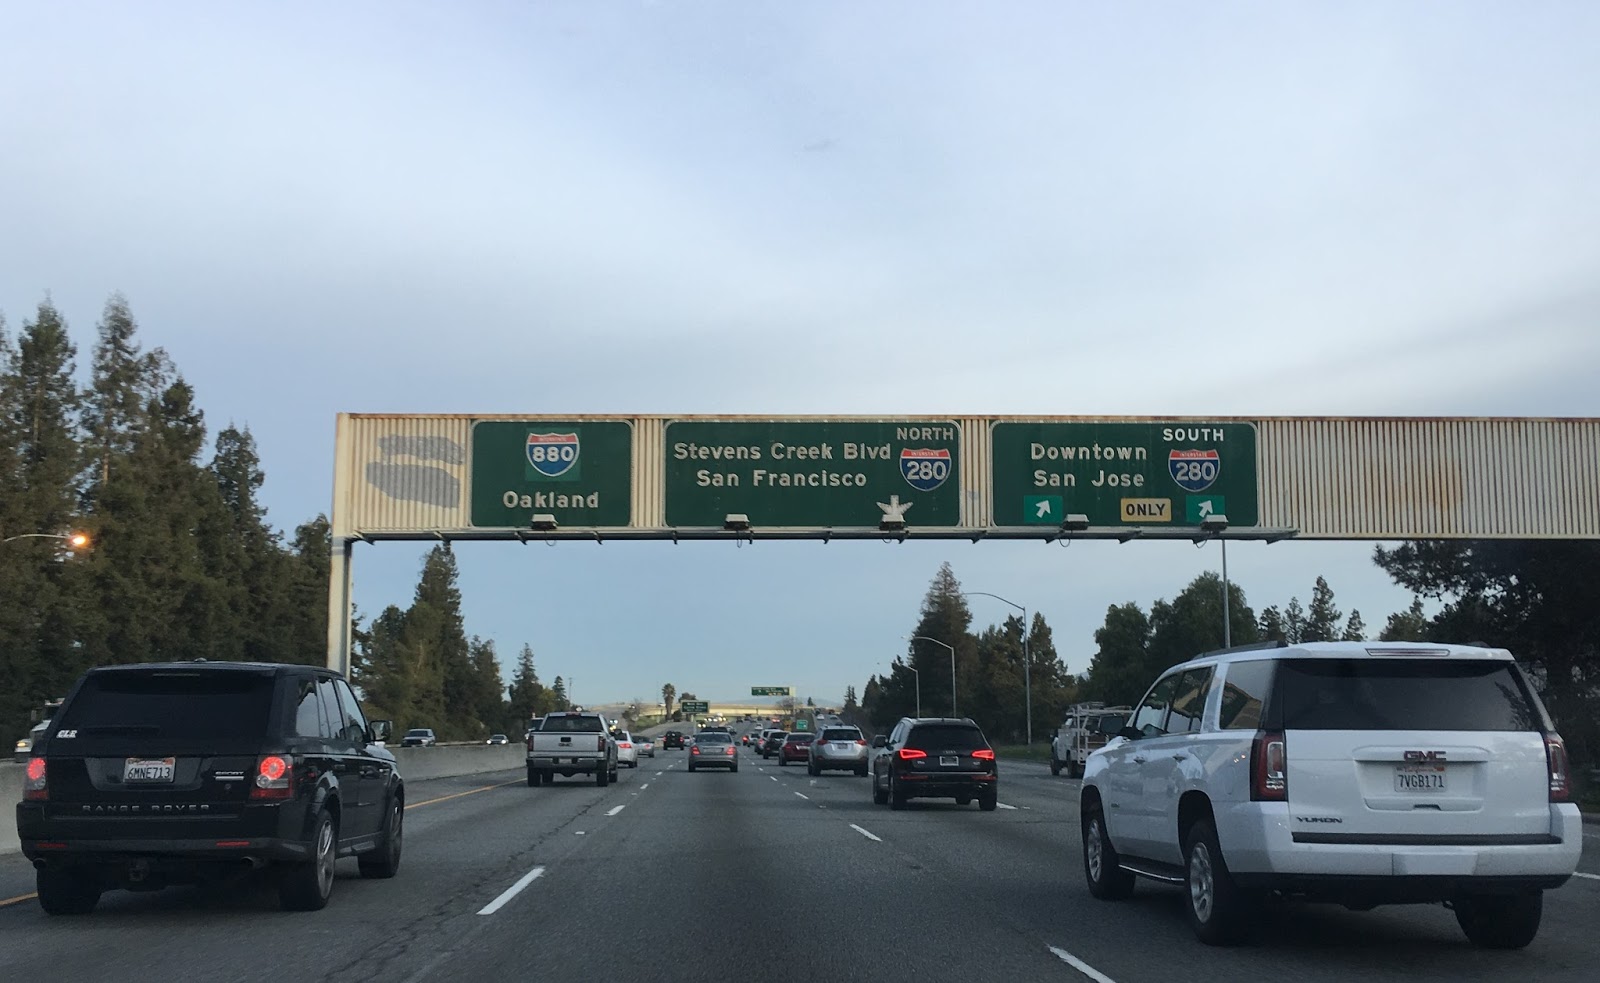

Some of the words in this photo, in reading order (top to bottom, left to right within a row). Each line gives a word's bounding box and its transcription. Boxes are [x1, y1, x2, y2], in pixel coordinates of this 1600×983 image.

[896, 427, 954, 441] NORTH
[1162, 428, 1224, 442] SOUTH
[532, 446, 574, 462] 880
[674, 442, 761, 460] Stevens
[770, 442, 833, 460] Creek
[844, 442, 891, 460] Blvd
[1031, 443, 1147, 460] Downtown
[906, 460, 946, 480] 280
[1175, 462, 1215, 481] 280
[696, 470, 740, 487] San
[753, 470, 867, 487] Francisco
[1033, 470, 1076, 487] San
[1090, 470, 1144, 487] Jose
[503, 490, 599, 508] Oakland
[1126, 504, 1166, 516] ONLY
[1403, 750, 1447, 761] GMC
[127, 766, 171, 780] 6MNE713
[1397, 774, 1444, 788] 7VGB171
[82, 804, 140, 812] RANGE
[150, 804, 210, 812] ROVER
